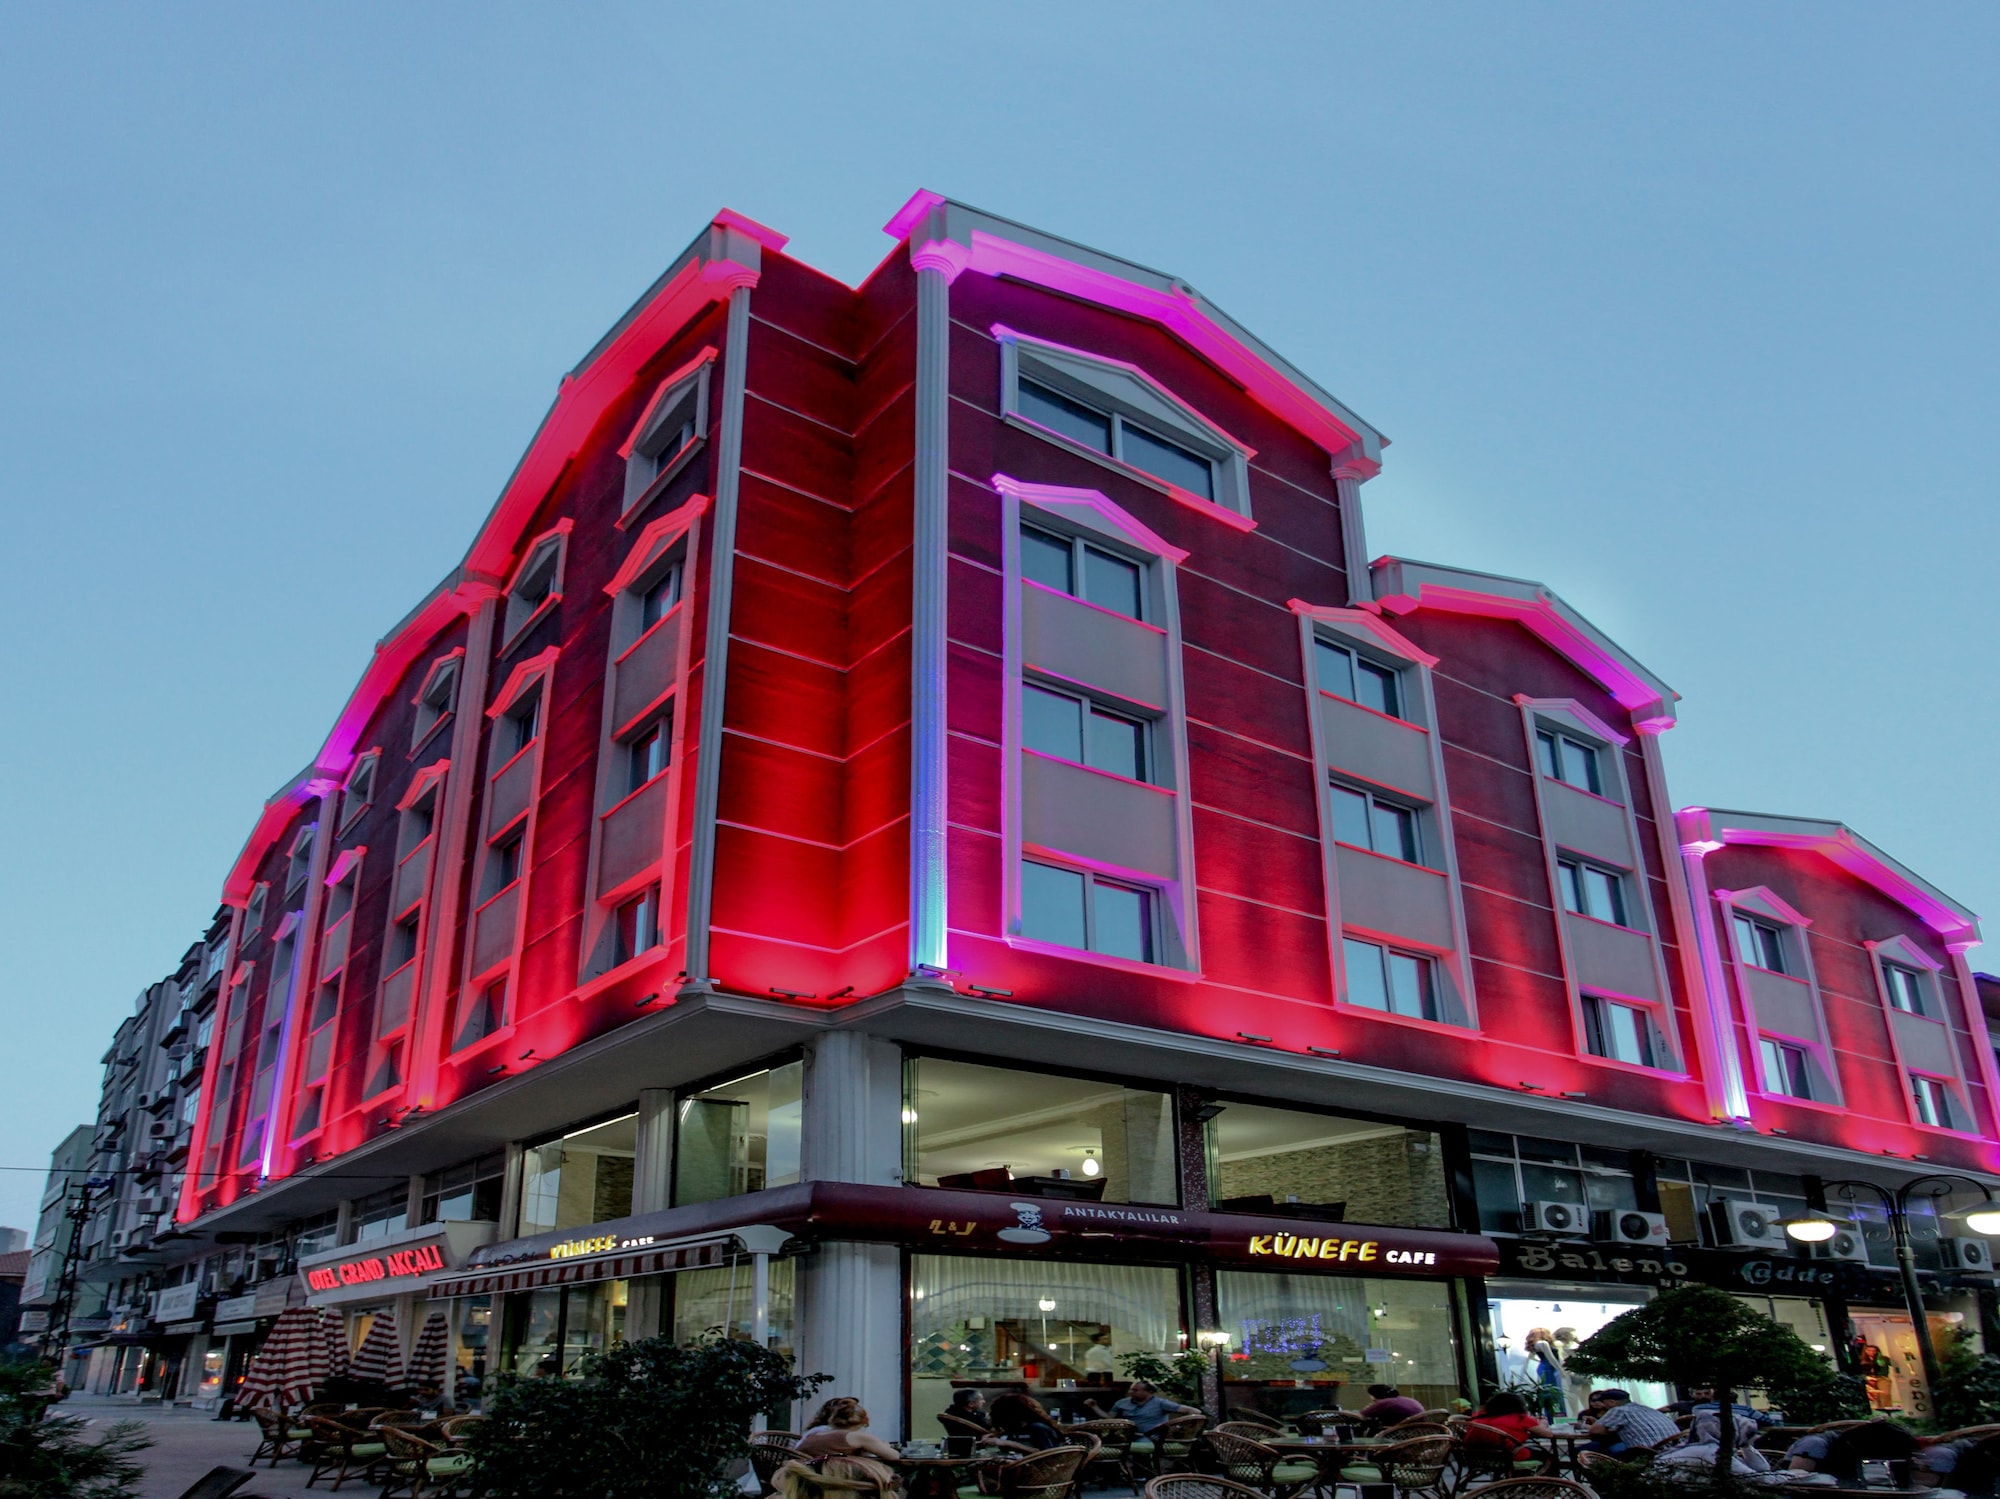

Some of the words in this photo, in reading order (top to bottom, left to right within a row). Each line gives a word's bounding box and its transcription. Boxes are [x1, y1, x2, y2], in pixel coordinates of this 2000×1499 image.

[1064, 1207, 1180, 1225] ANTAKYALILAR
[1249, 1231, 1379, 1262] KÜNEFE
[1386, 1250, 1436, 1265] CAFE
[1516, 1243, 1688, 1276] Baleno
[308, 1267, 341, 1291] OTEL
[339, 1258, 385, 1285] GRAND
[386, 1245, 445, 1277] AKÇALI
